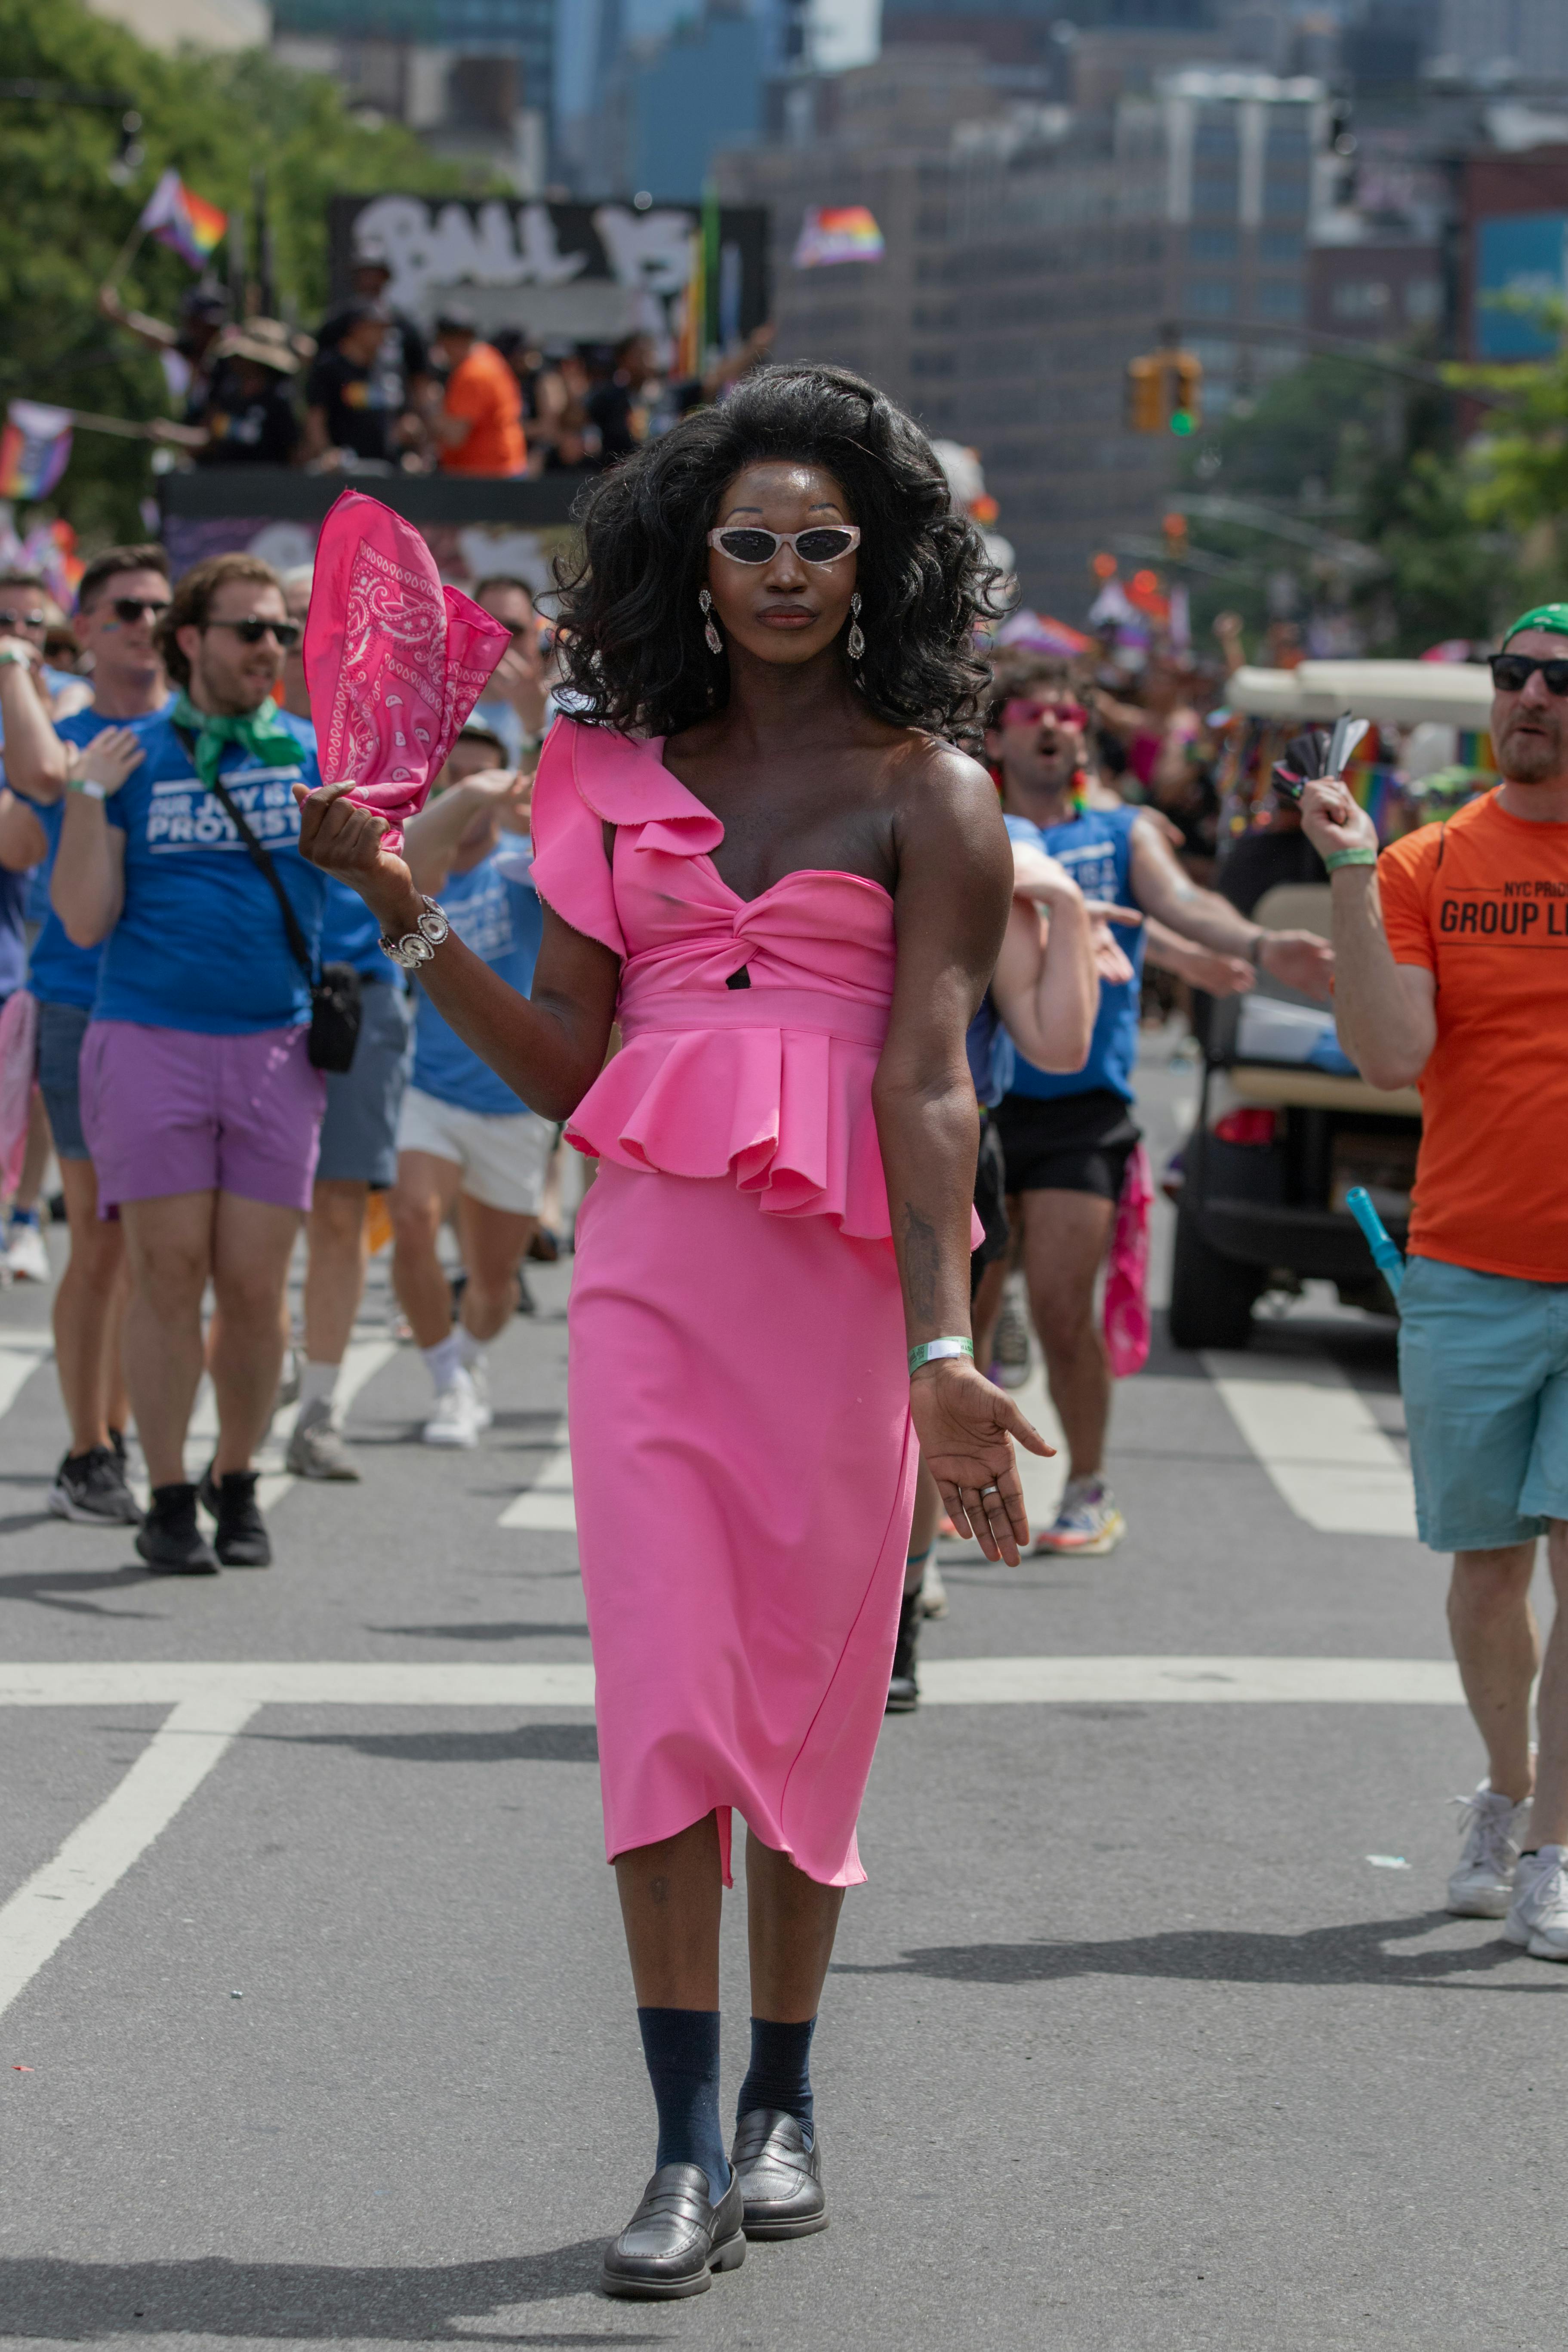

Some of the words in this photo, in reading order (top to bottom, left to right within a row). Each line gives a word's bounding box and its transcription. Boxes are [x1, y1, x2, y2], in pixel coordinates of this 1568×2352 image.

[1505, 881, 1531, 897] NYC
[1440, 900, 1539, 935] GROUP
[1548, 902, 1568, 936] L
